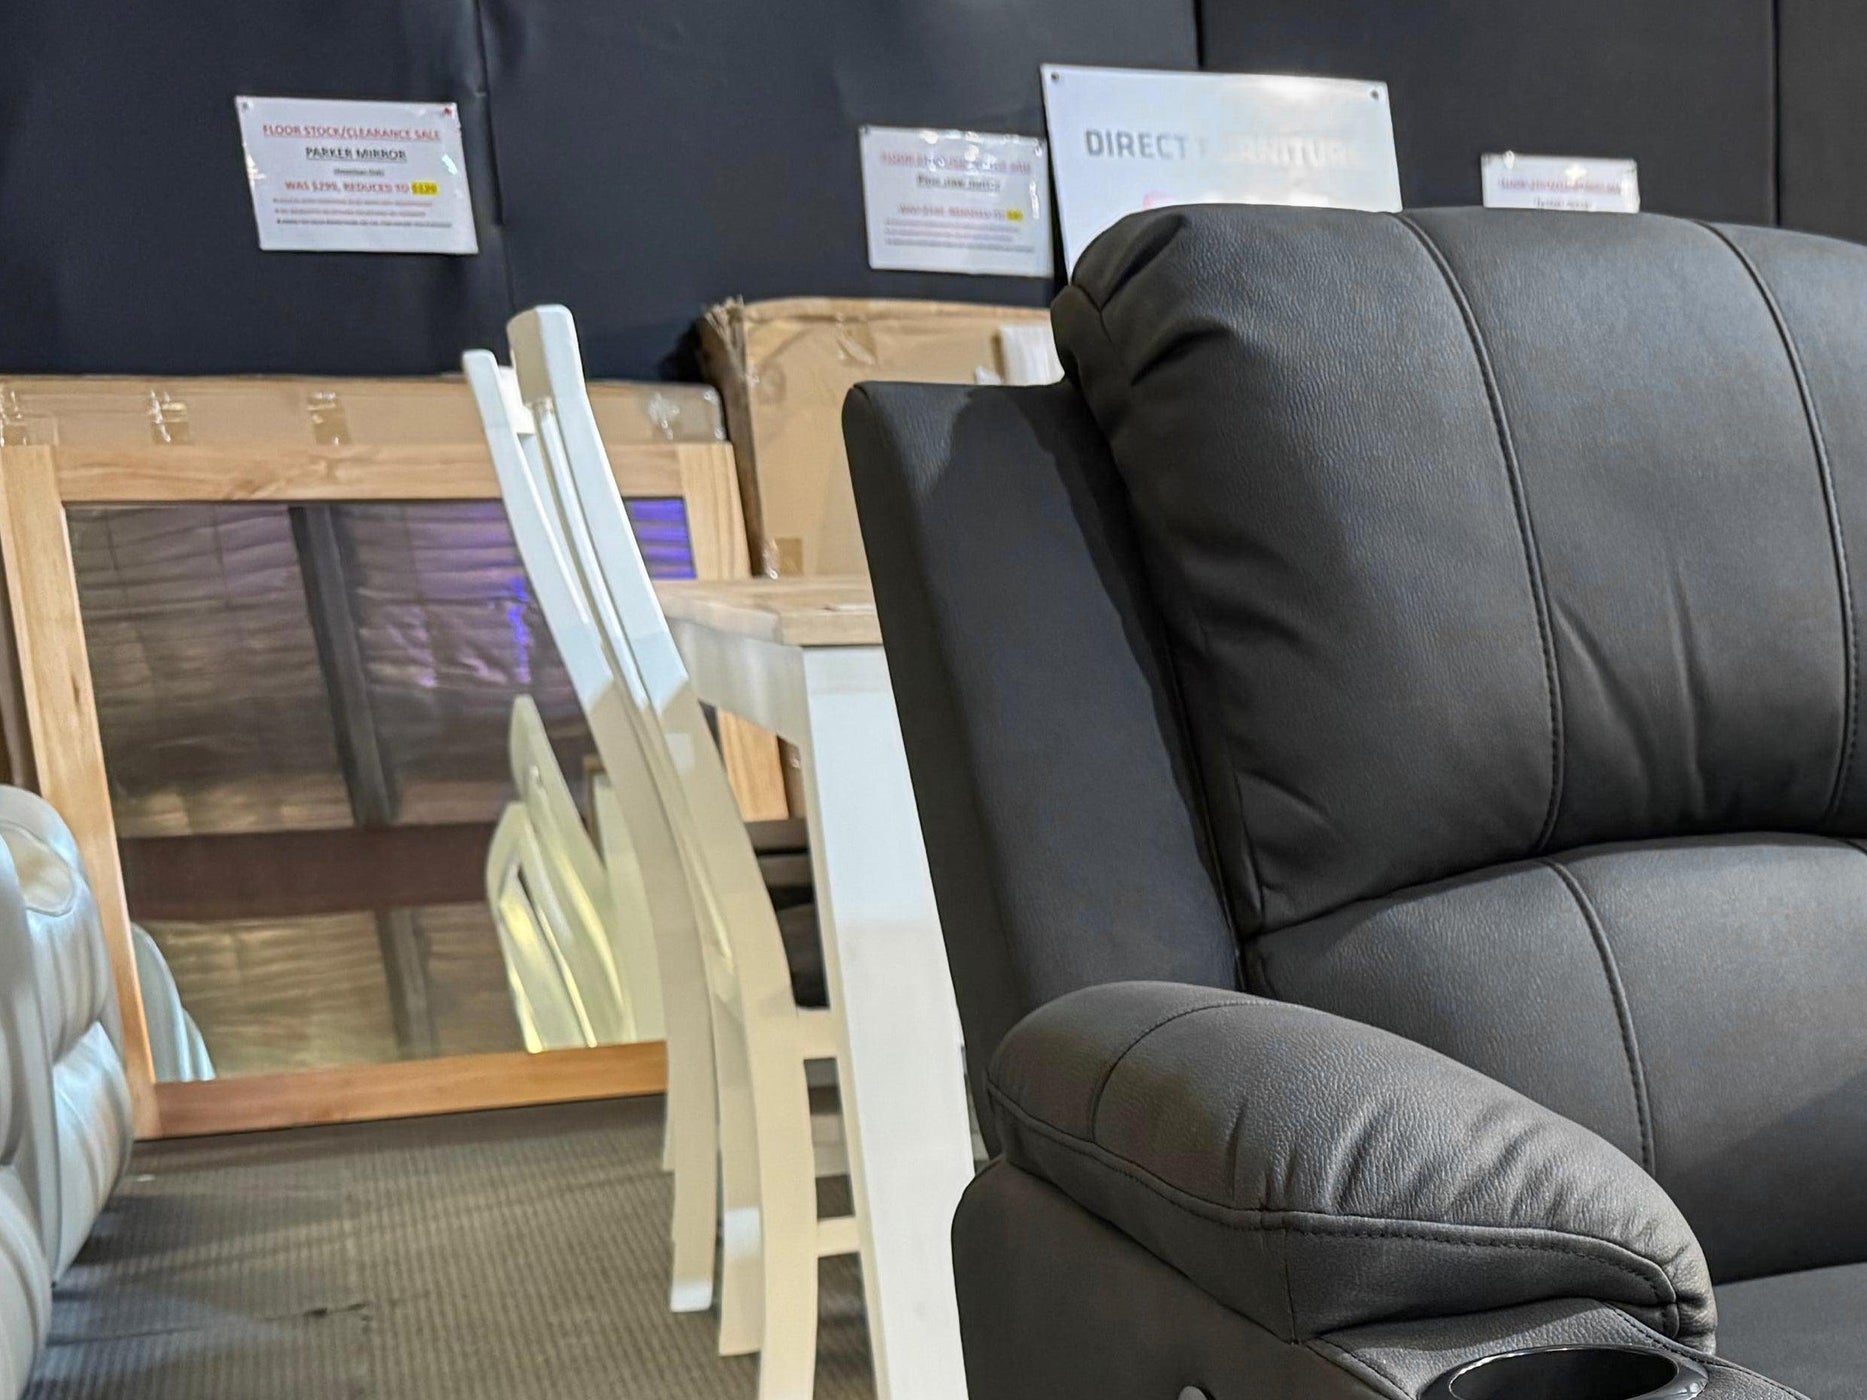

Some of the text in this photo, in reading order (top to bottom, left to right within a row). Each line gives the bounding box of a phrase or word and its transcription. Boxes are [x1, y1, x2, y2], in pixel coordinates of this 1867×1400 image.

[263, 124, 300, 137] FLOOR
[305, 147, 407, 161] PARKER MIRROR
[1085, 128, 1353, 167] DIRECT FRNITUR
